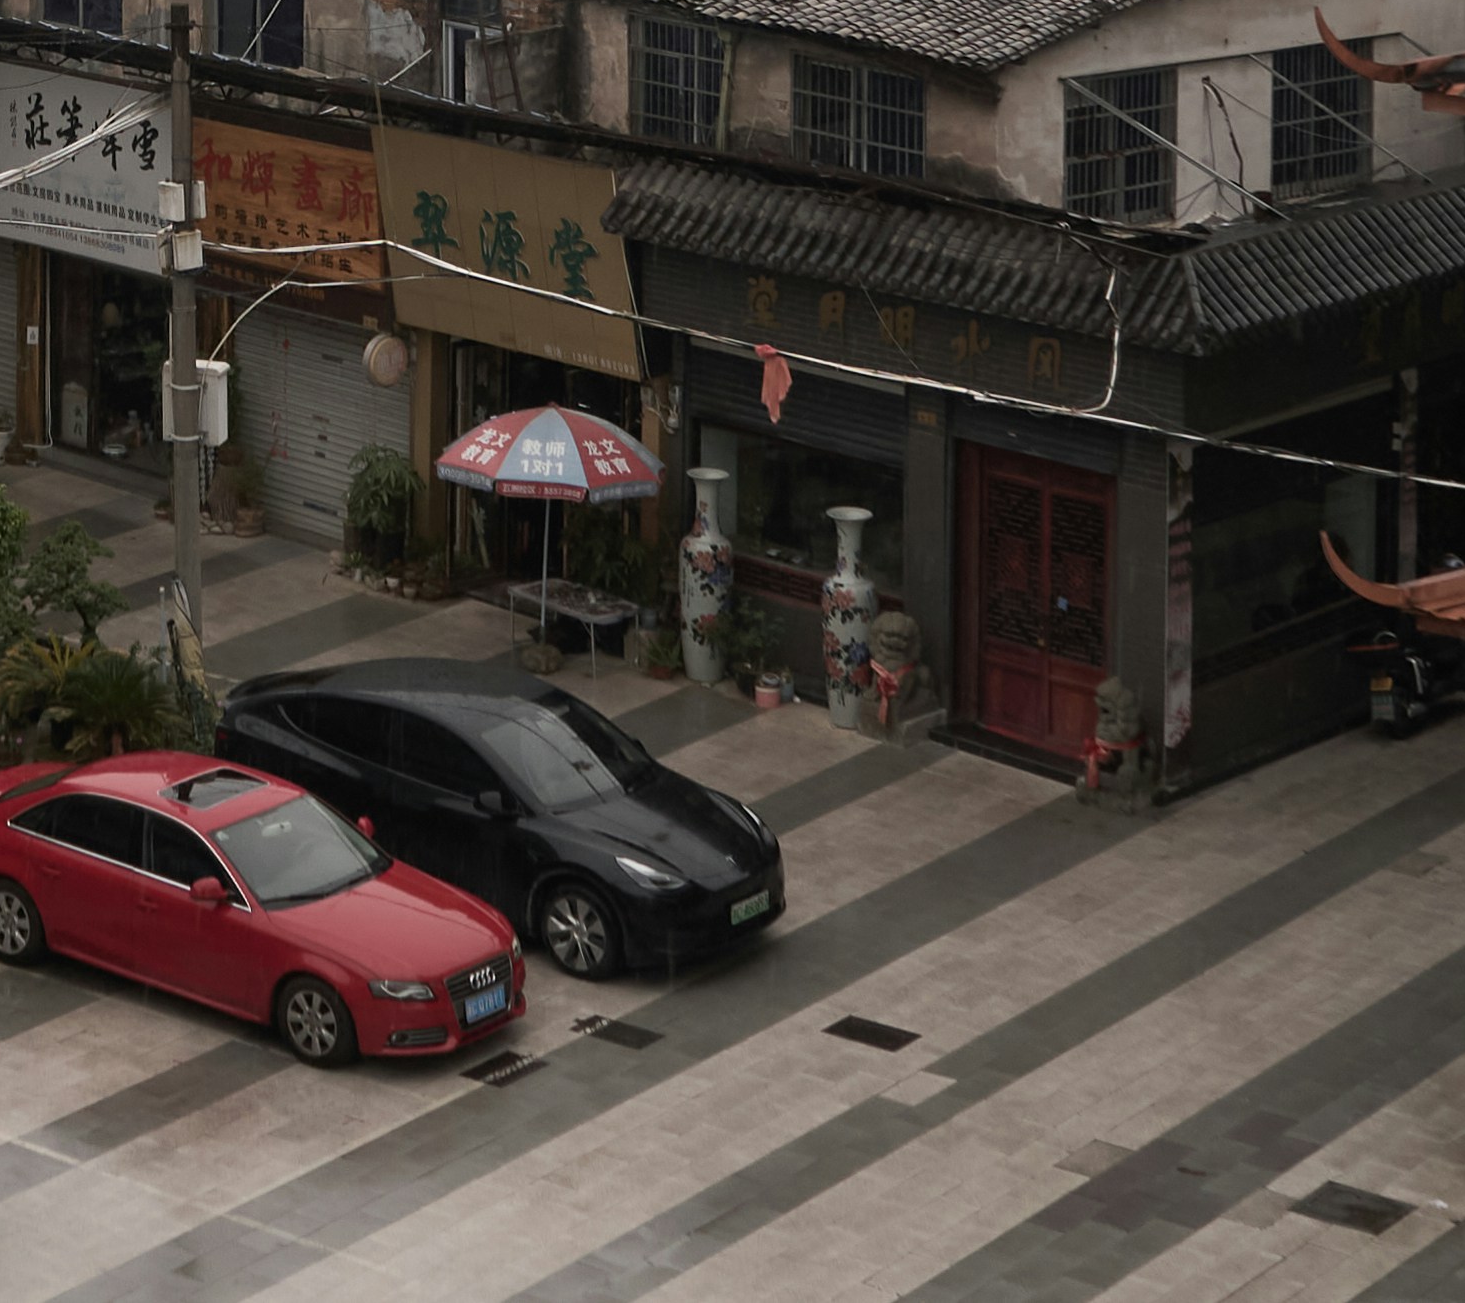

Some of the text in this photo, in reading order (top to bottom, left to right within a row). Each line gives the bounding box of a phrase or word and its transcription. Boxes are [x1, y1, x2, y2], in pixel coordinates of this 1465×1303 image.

[412, 190, 599, 301] 翠源堂
[474, 427, 513, 449] 龙文
[521, 438, 567, 458] 教师
[581, 437, 622, 457] 龙文
[460, 444, 499, 466] 教育
[520, 459, 564, 477] 1对1
[593, 456, 632, 477] 教育
